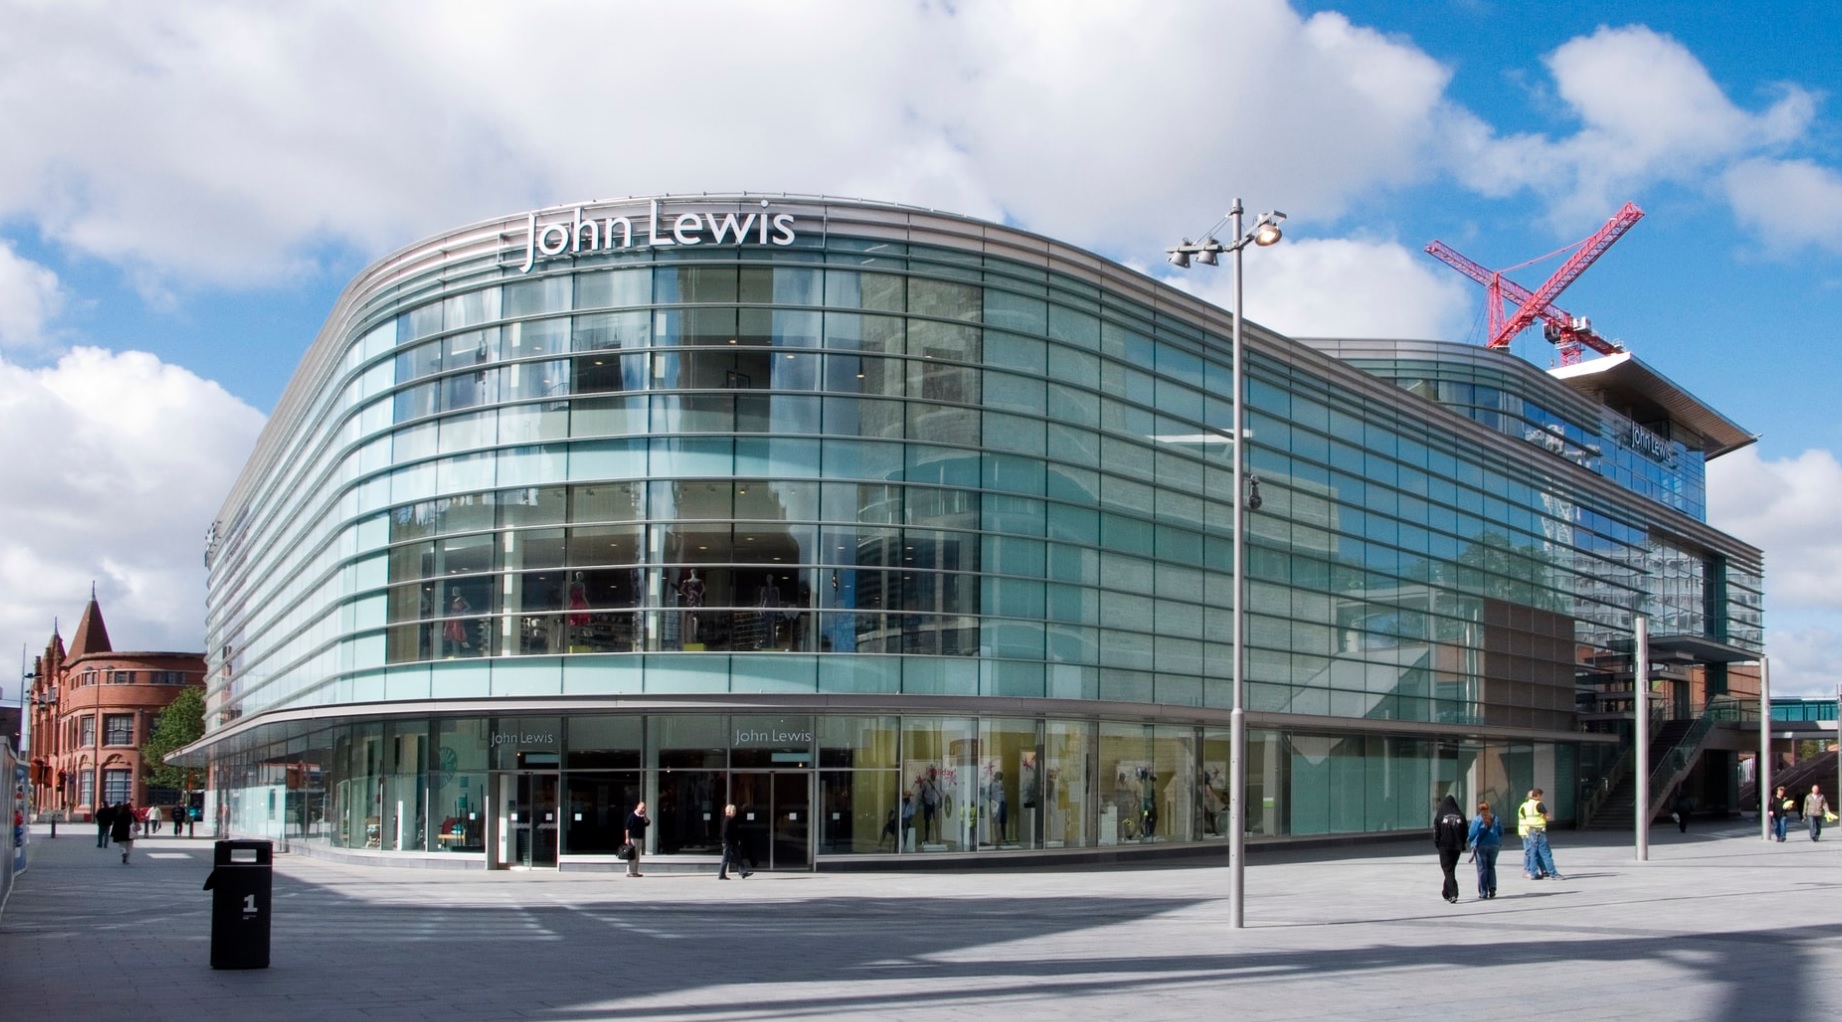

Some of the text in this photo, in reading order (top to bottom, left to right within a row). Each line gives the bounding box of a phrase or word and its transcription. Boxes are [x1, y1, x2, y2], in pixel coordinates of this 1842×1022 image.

[520, 198, 795, 273] John Lewis
[1631, 420, 1672, 462] John Lewis
[490, 730, 553, 748] John Lewis
[735, 729, 812, 746] John Lewis
[243, 894, 258, 912] 1
